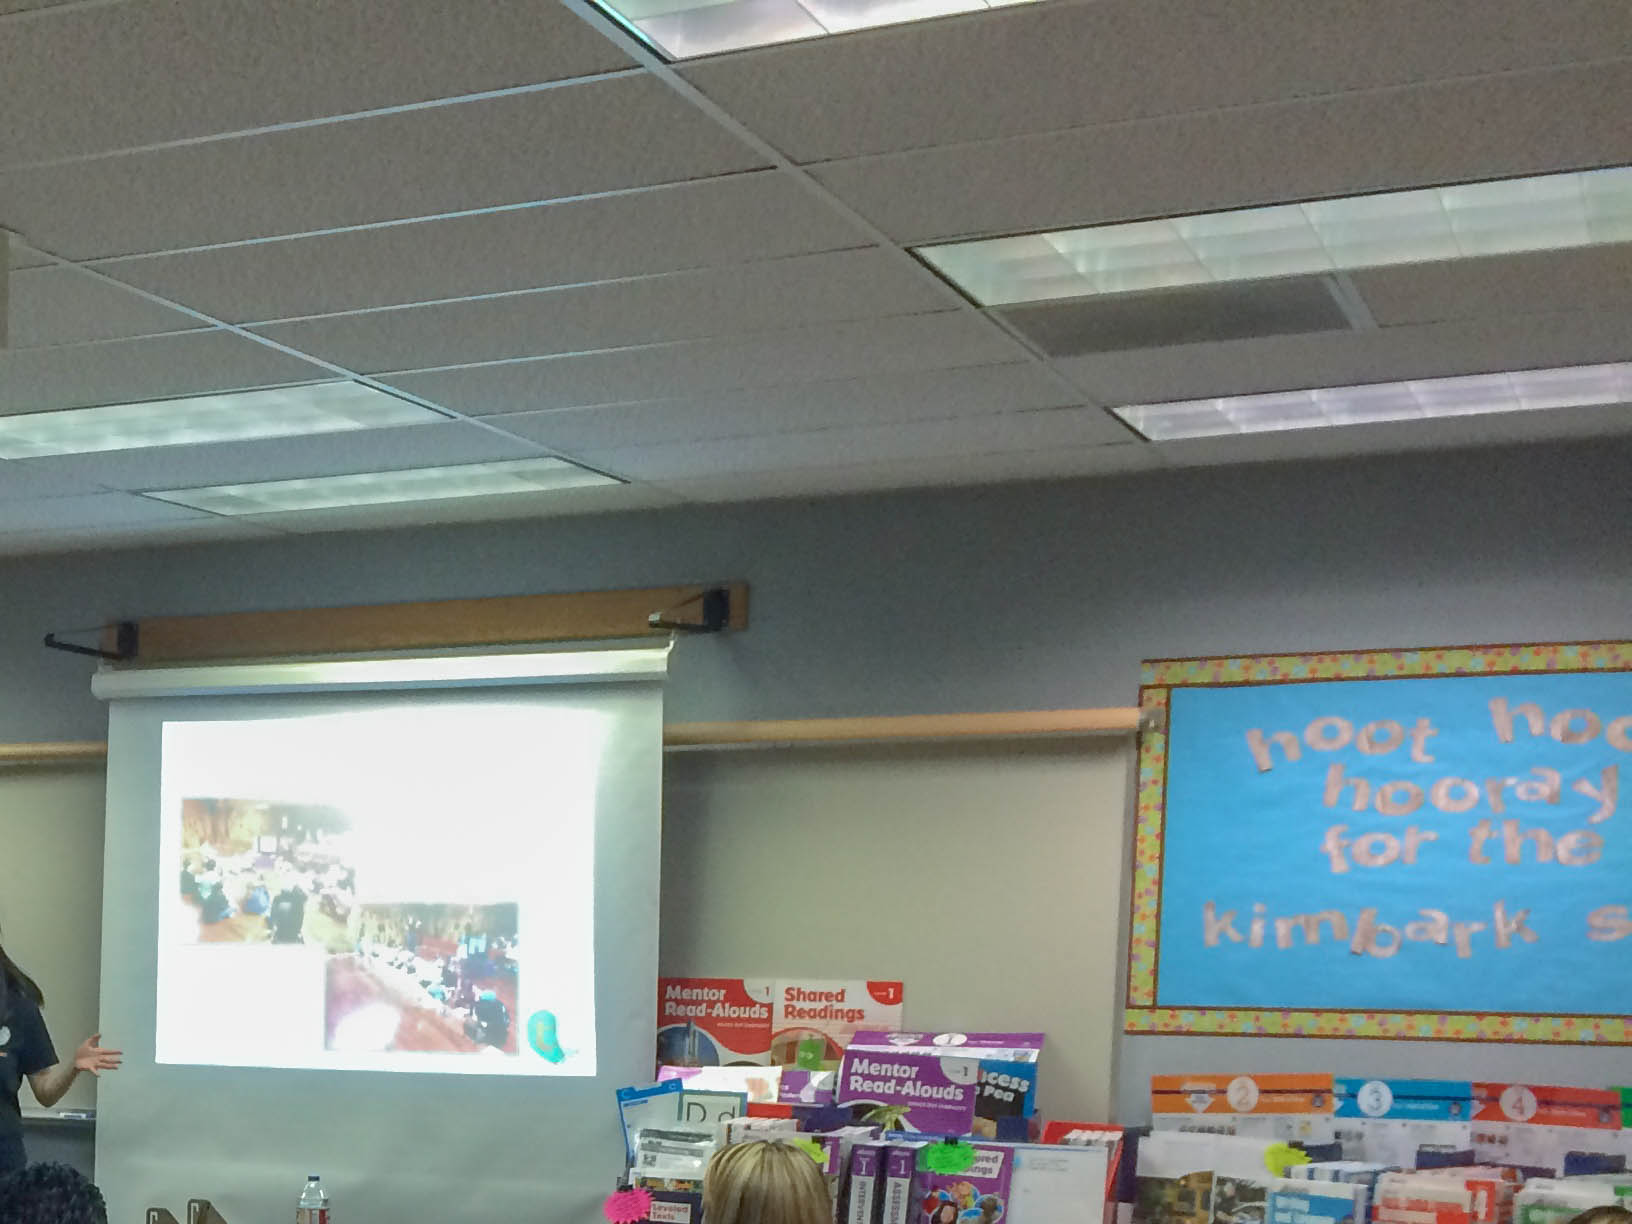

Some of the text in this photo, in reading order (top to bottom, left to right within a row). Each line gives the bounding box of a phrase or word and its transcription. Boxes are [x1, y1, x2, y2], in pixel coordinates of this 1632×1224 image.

[1245, 715, 1439, 773] hoot
[1322, 763, 1619, 824] hooray
[1320, 818, 1604, 874] for the
[1202, 899, 1538, 959] kimbark
[665, 985, 727, 1000] Mentor
[784, 987, 846, 1003] Shared
[665, 1001, 768, 1018] Read-Alouds
[784, 1004, 865, 1023] Readings
[851, 1058, 920, 1079] Mentor
[850, 1075, 965, 1101] Read-Alouds
[983, 1085, 1014, 1102] Pea
